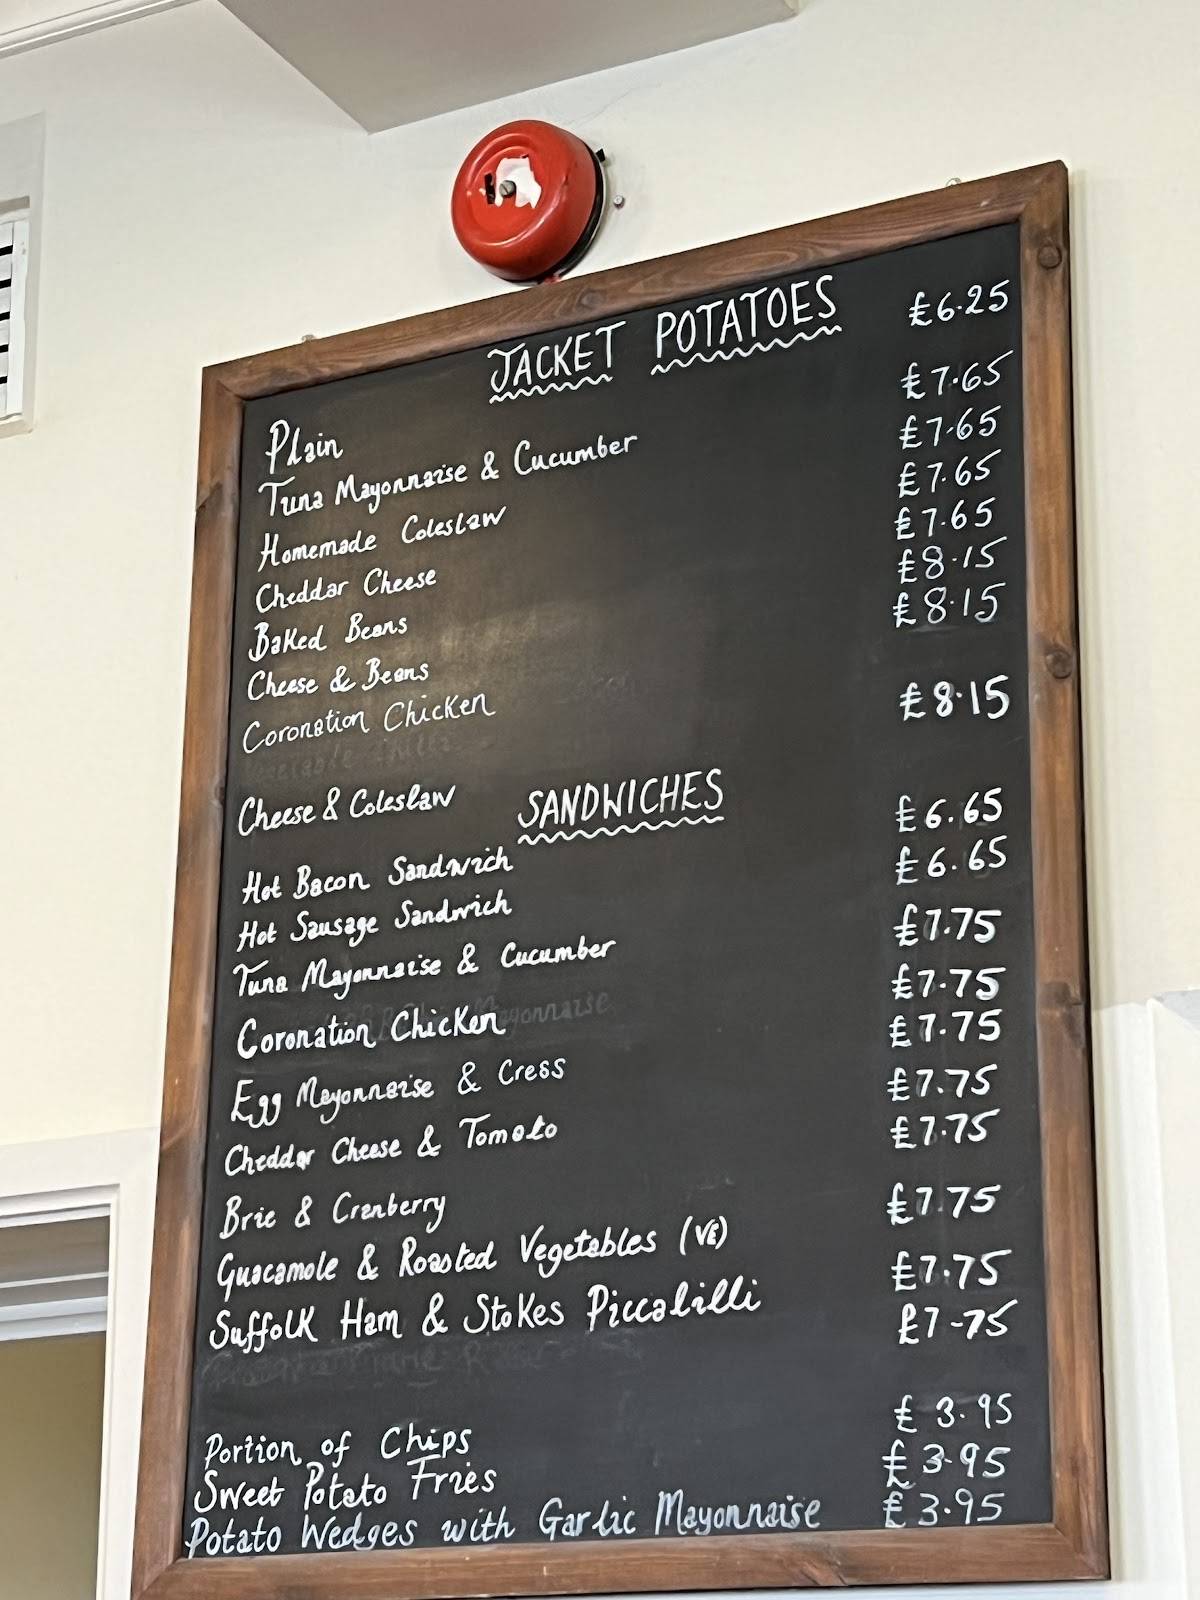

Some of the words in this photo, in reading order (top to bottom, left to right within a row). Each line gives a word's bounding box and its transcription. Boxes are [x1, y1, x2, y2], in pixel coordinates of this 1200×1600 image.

[487, 321, 626, 391] JACKET
[656, 275, 837, 358] POTATOES
[258, 476, 323, 518] Tuna
[335, 463, 468, 514] Mayonnaise
[481, 452, 500, 480] &
[513, 434, 638, 477] Cucumber
[265, 419, 343, 475] Plain
[258, 530, 377, 572] Homemade
[402, 506, 506, 544] Coleslaw
[256, 574, 349, 613] Cheddar
[364, 567, 437, 596] Cheese
[345, 612, 408, 643] Beans
[247, 670, 318, 702] Cheese
[329, 665, 356, 693] &
[363, 658, 430, 692] Beans
[243, 709, 370, 755] Coronation
[238, 795, 316, 837] Cheese
[322, 787, 339, 820] &
[350, 783, 456, 818] Coleslaw
[518, 768, 724, 829] SANDWICHES
[242, 870, 281, 905] Hot
[292, 866, 370, 899] Bacon
[387, 846, 513, 887] Sandwich
[237, 920, 276, 953] Hot
[290, 910, 378, 947] Sausage
[395, 890, 512, 929] Sandwich
[232, 960, 288, 998] Tuna
[301, 955, 441, 1000] Mayonnaise
[456, 943, 479, 975] &
[501, 936, 616, 969] Cucumber
[237, 1016, 376, 1059] Coronation
[231, 1079, 282, 1128] Egg
[296, 1075, 435, 1123] Mayonnaise
[457, 1062, 482, 1095] &
[499, 1057, 566, 1086] Cress
[224, 1144, 315, 1177] Cheddar
[332, 1135, 402, 1164] Cheese
[417, 1126, 441, 1159] &
[458, 1113, 558, 1150] Tomato
[219, 1196, 277, 1240] Brie
[294, 1195, 311, 1228] &
[333, 1190, 446, 1234] Cranberry
[217, 1251, 336, 1302] Guacamole
[356, 1244, 379, 1280] &
[399, 1236, 498, 1279] Roasted
[519, 1224, 656, 1279] Vegetables
[679, 1216, 729, 1256] (VE)
[340, 1299, 403, 1341] Ham
[422, 1292, 448, 1336] &
[586, 1275, 762, 1332] Piccalilli
[205, 1433, 301, 1470] Portion
[321, 1430, 352, 1466] of
[380, 1422, 472, 1460] Chips
[193, 1469, 285, 1513] Sweet
[304, 1461, 388, 1510] Potato
[407, 1454, 497, 1500] Fries
[185, 1518, 283, 1559] Potato
[301, 1515, 419, 1551] Wedges
[442, 1507, 515, 1544] with
[539, 1497, 638, 1542] Garlic
[654, 1491, 821, 1539] Mayonnaise
